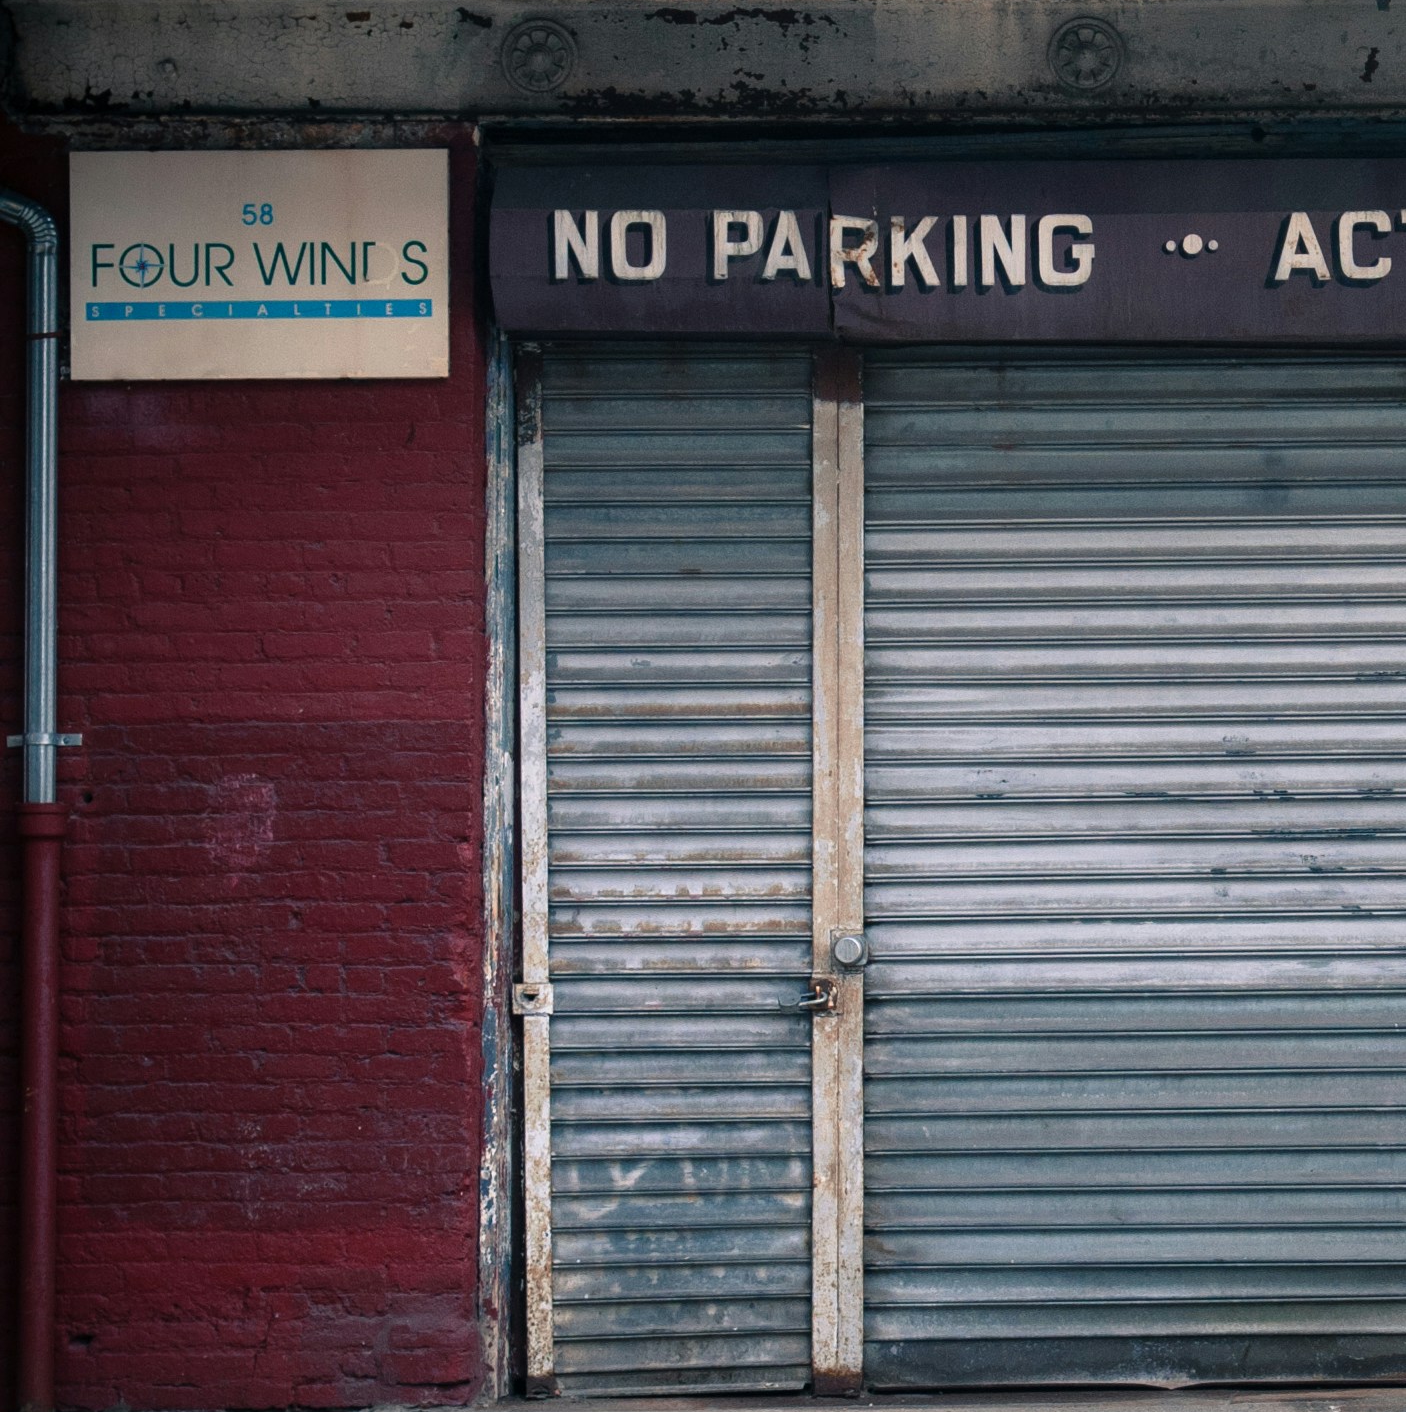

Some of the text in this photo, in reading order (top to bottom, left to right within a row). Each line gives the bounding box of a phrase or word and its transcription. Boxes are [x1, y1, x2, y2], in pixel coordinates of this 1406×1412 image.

[241, 203, 274, 226] 58
[91, 242, 235, 288] FOUR
[555, 209, 1096, 288] NO PARKING
[91, 301, 428, 318] SPECIALTIES
